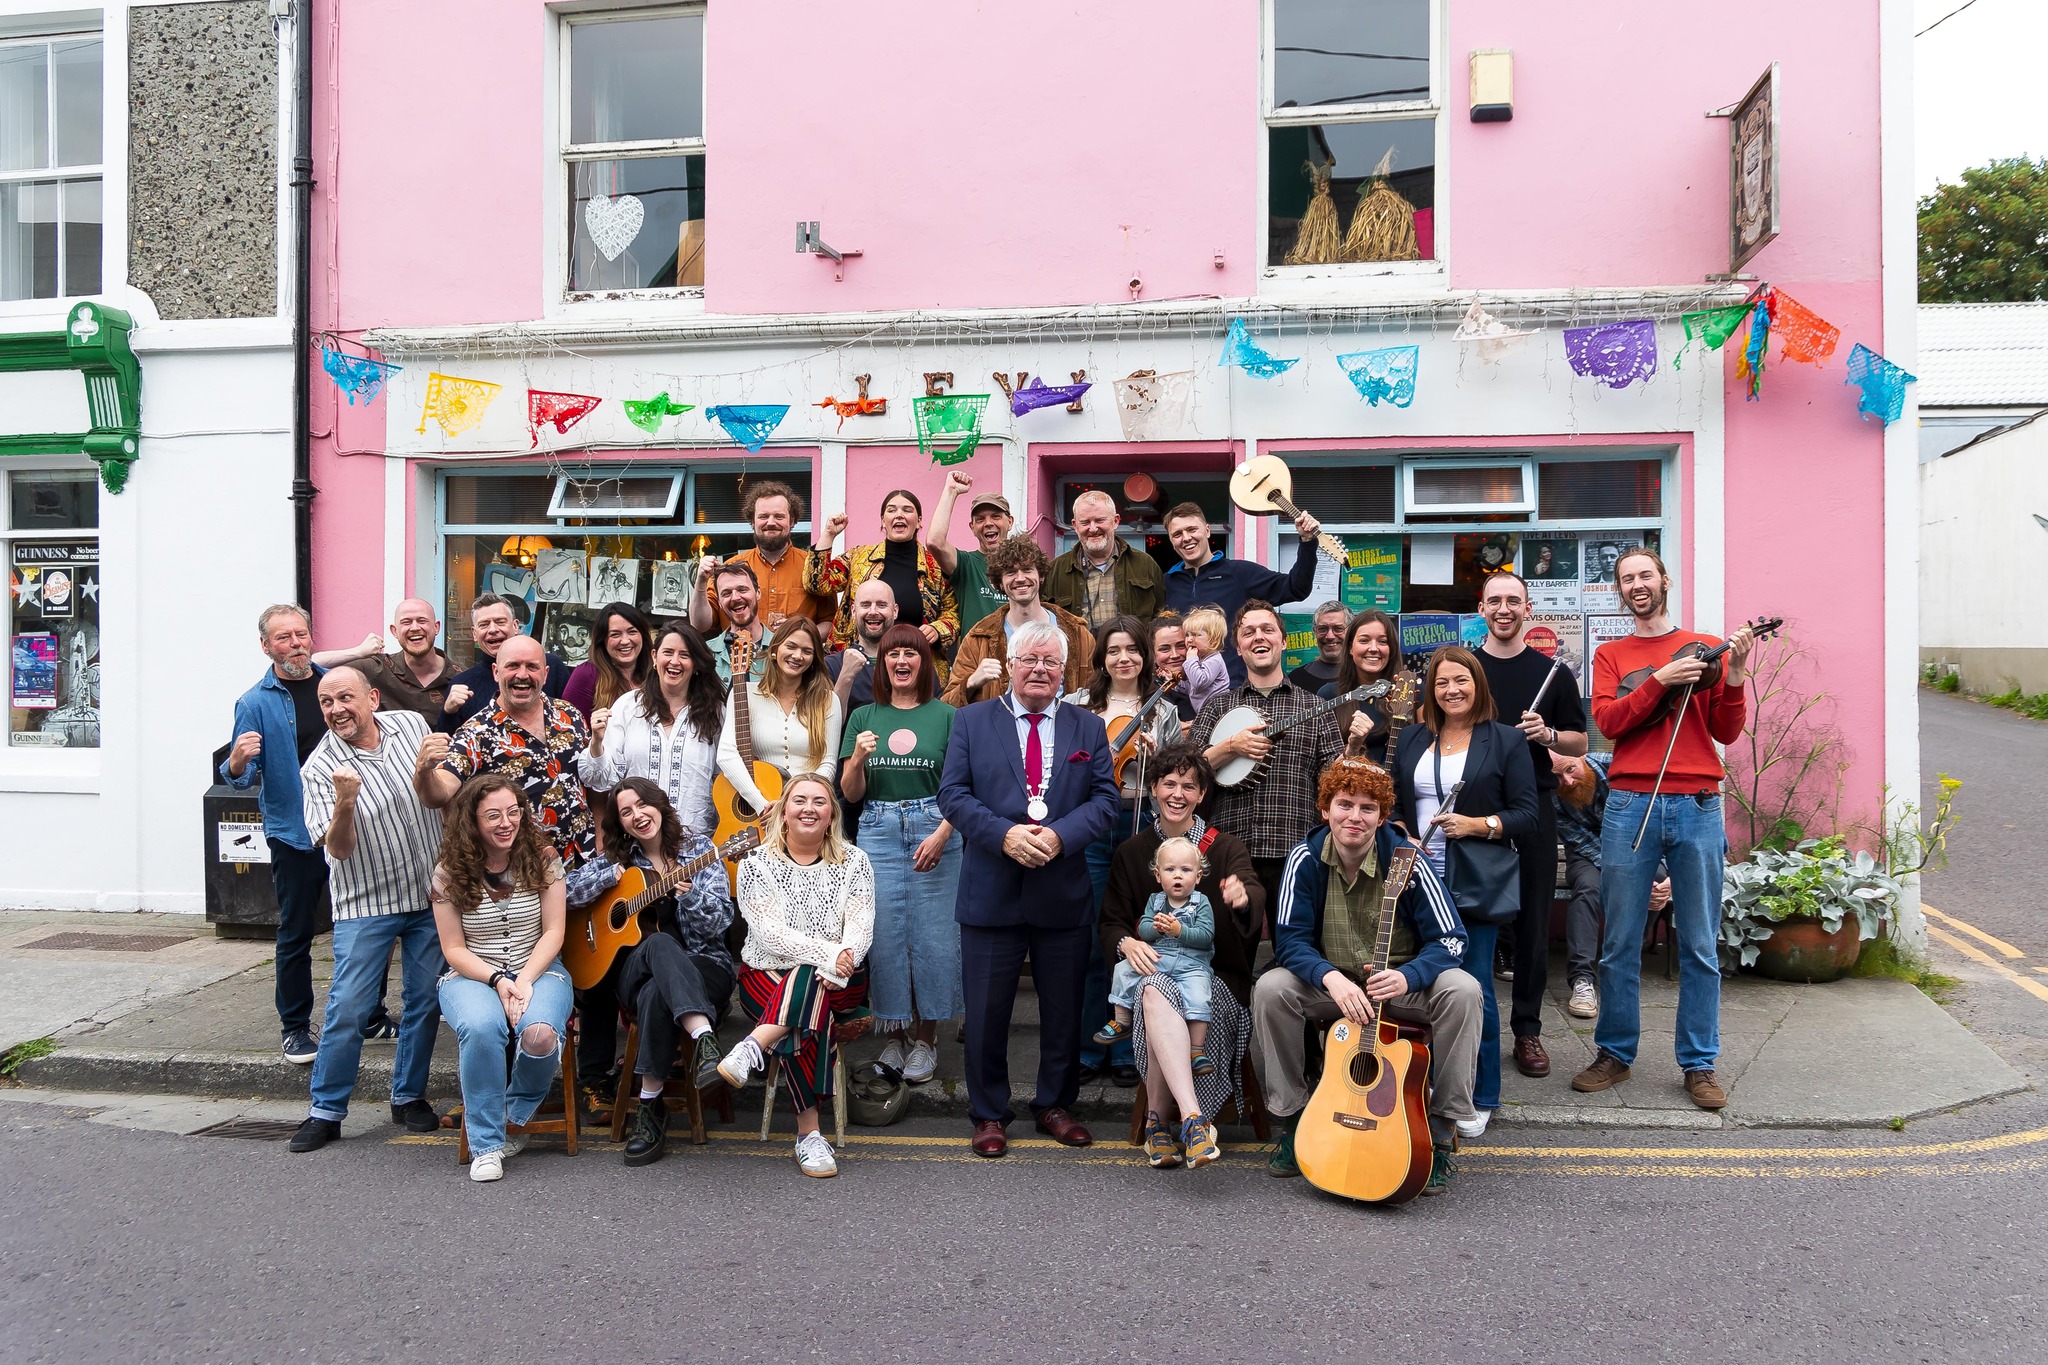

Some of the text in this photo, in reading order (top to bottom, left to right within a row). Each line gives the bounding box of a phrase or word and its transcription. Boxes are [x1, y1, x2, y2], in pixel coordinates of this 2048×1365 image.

[1523, 531, 1577, 539] LIVE AT LEVIS
[17, 547, 69, 559] GUINNESS
[1590, 619, 1634, 627] BAREFOO
[868, 757, 935, 769] SUAIMHNEAS
[222, 811, 263, 822] LITTER
